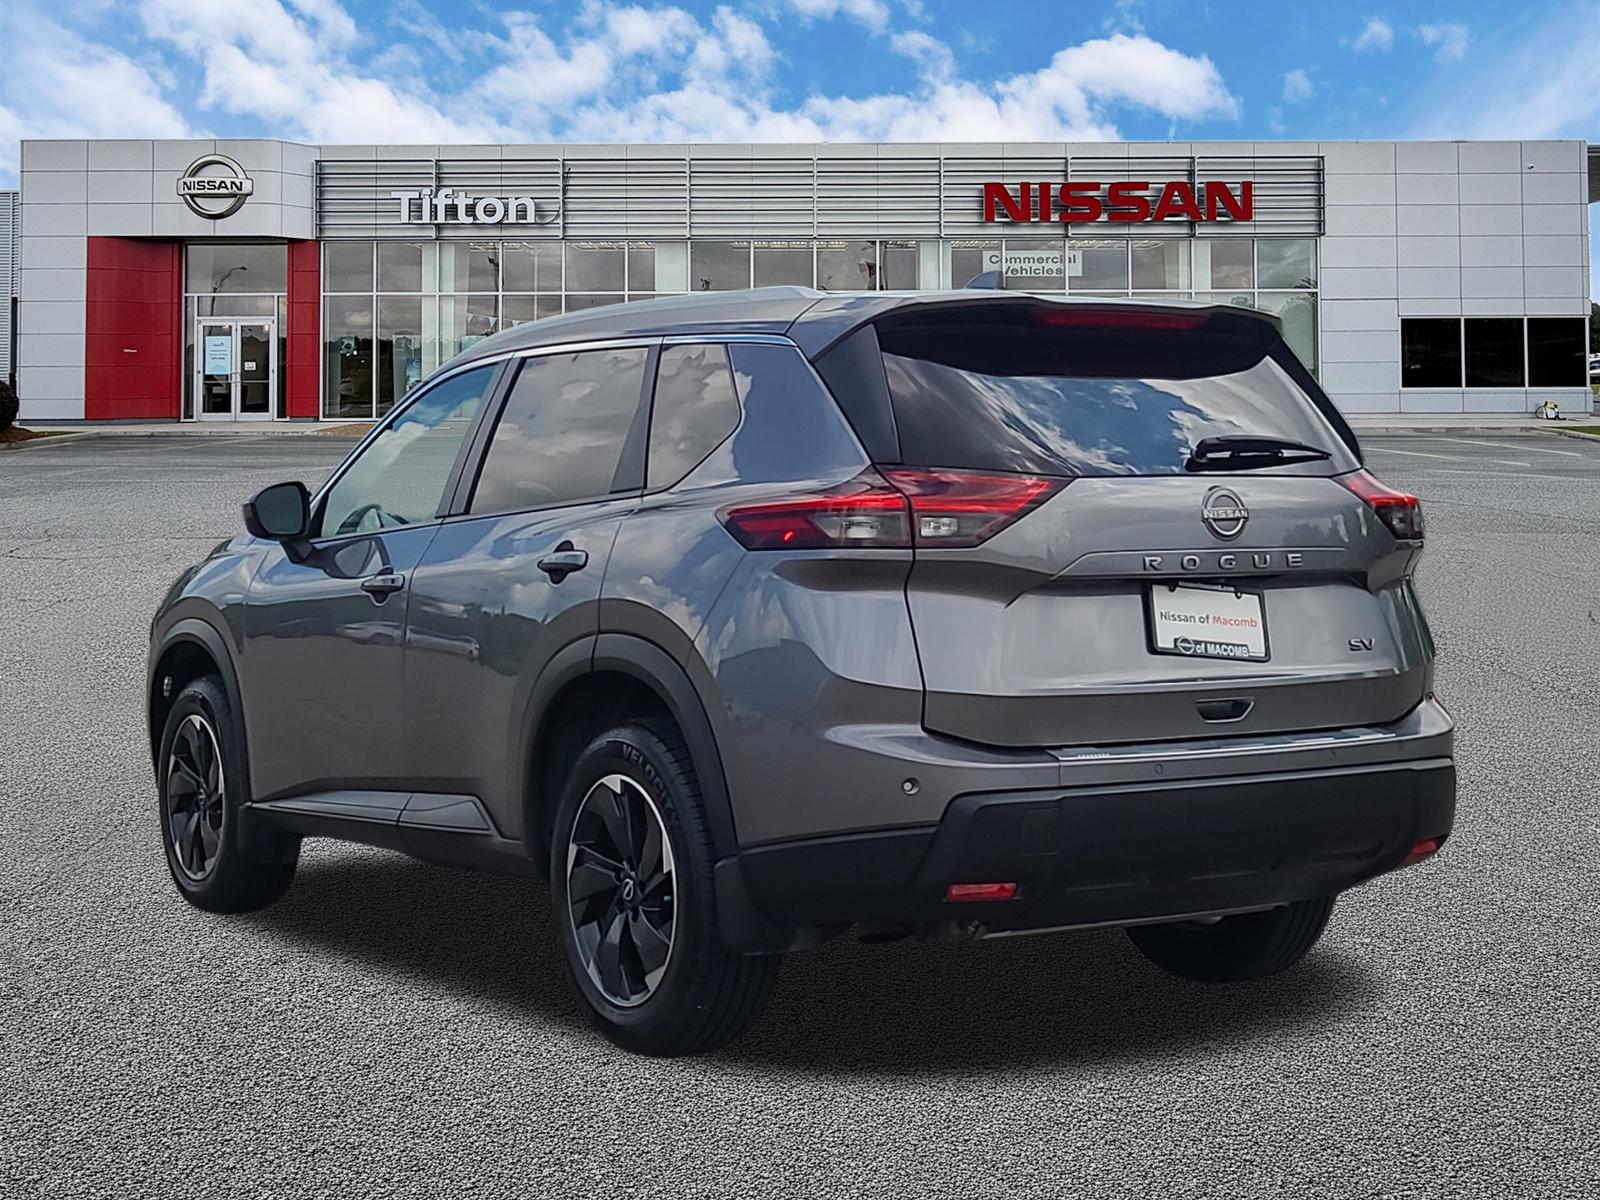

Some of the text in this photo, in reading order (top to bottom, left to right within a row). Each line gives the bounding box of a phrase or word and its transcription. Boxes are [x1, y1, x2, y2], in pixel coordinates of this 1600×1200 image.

[182, 180, 243, 192] NISSAN
[390, 187, 536, 224] Tifton
[984, 181, 1253, 222] NISSAN
[1203, 508, 1248, 519] NISSAN
[1143, 553, 1304, 571] ROGUE
[1160, 610, 1258, 628] Nissan of Macomb
[1195, 642, 1206, 654] of
[1206, 644, 1249, 657] MACOMB
[1348, 637, 1376, 652] SV
